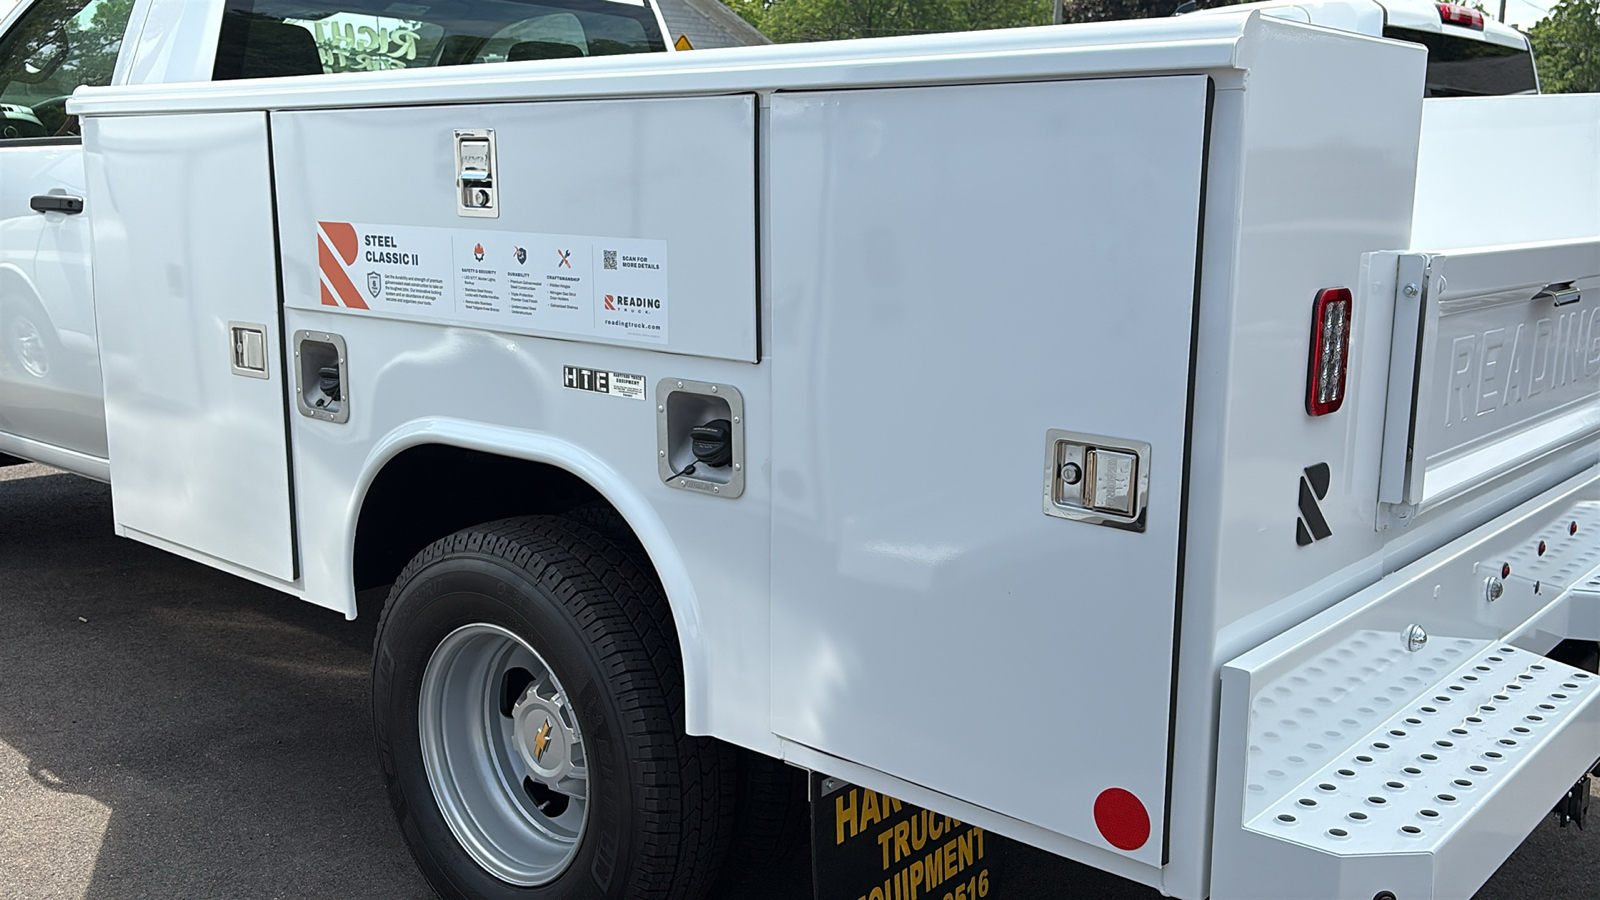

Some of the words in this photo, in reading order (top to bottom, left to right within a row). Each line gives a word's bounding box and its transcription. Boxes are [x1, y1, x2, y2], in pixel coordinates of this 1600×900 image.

[364, 234, 397, 248] STEEL
[365, 250, 409, 265] CLASSIC
[411, 254, 419, 266] II
[617, 295, 661, 309] READING
[605, 320, 661, 330] readingtruck.com
[1444, 305, 1600, 428] READING
[564, 366, 608, 393] HTE
[857, 826, 984, 900] UIPMENT
[942, 868, 989, 900] 516
